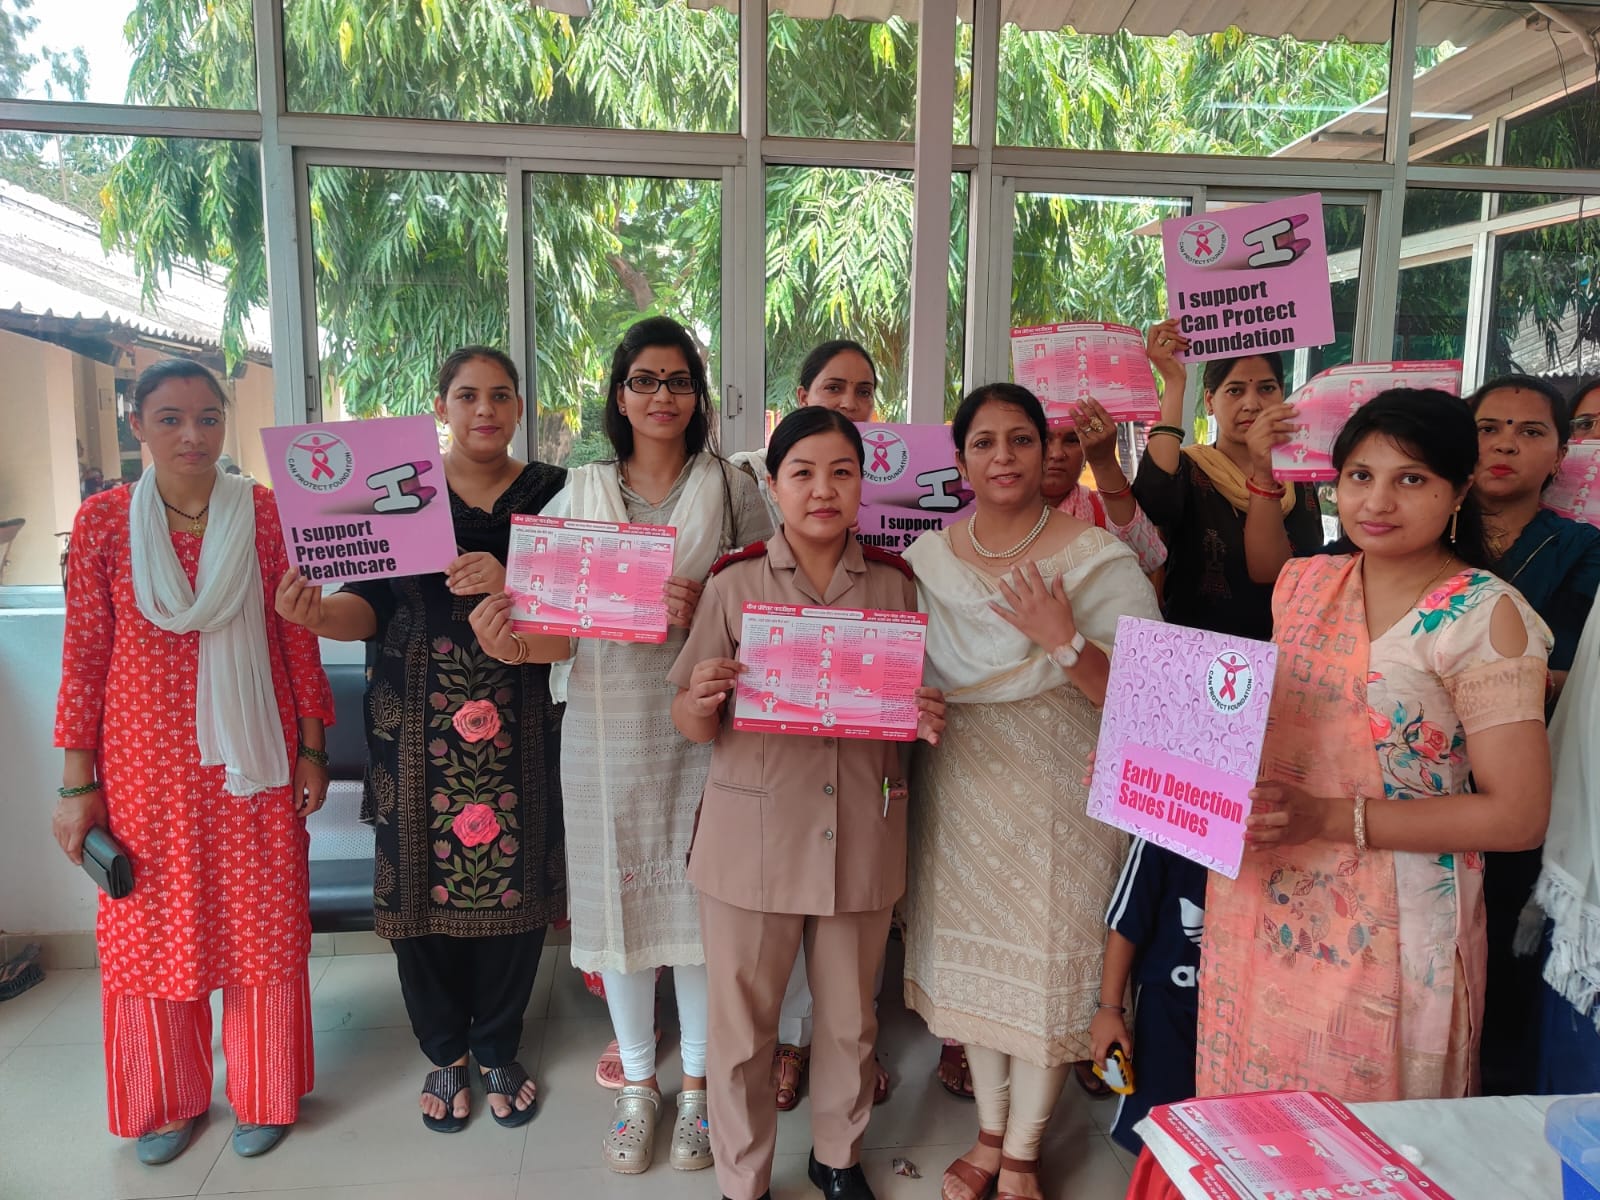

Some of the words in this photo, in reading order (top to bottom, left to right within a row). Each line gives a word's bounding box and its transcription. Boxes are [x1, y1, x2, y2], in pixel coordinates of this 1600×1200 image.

[1183, 254, 1206, 264] PROTECT
[1207, 234, 1226, 263] FOUNDATION
[1179, 292, 1185, 310] I
[1190, 281, 1267, 308] support
[1181, 315, 1218, 333] Can
[1223, 301, 1296, 328] Protect
[288, 458, 298, 474] CAN
[295, 473, 327, 491] PROTECT
[329, 451, 351, 488] FOUNDATION
[863, 471, 881, 482] OTECT
[884, 451, 908, 482] FOUNDATION
[292, 527, 298, 543] I
[302, 520, 373, 543] support
[881, 515, 885, 529] I
[889, 518, 942, 531] support
[296, 539, 390, 562] Preventive
[856, 533, 900, 547] egular
[299, 558, 396, 580] Healthcare
[1209, 686, 1227, 710] PROTECT
[1227, 678, 1252, 711] FOUNDATION
[1122, 759, 1161, 794] Early
[1163, 772, 1244, 824] Detection
[1118, 782, 1164, 819] Saves
[1167, 802, 1208, 837] Lives
